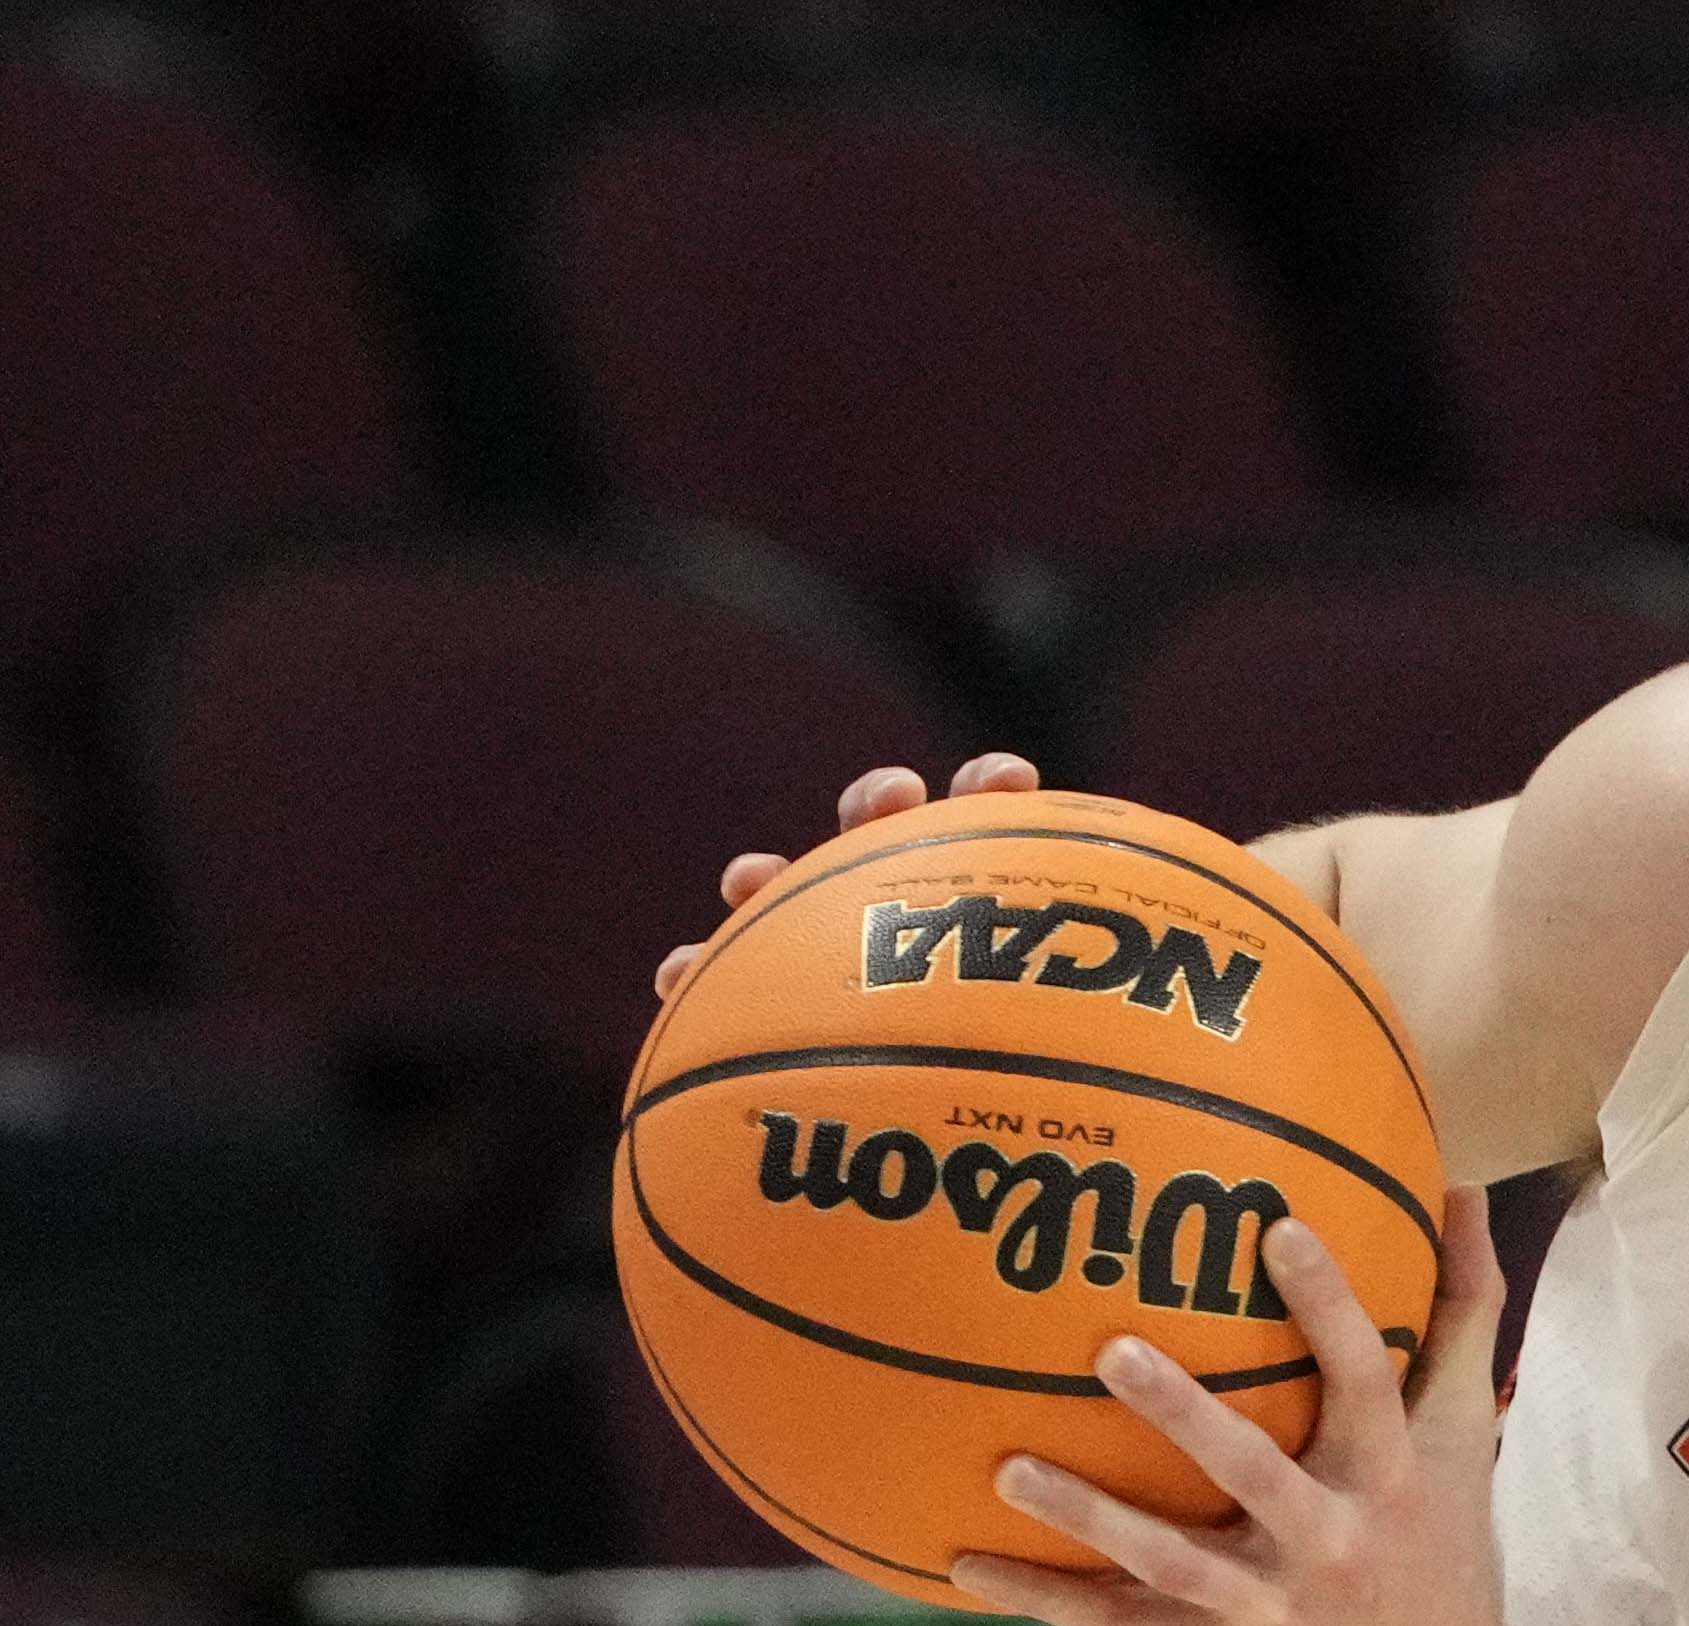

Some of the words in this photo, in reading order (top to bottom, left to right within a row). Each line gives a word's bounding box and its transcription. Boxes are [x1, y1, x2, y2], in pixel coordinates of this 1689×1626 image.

[1112, 886, 1267, 951] OFFICIAL
[863, 895, 1262, 1041] NCAA
[945, 1107, 1023, 1134] NXT
[1038, 1118, 1115, 1147] EVO
[758, 1109, 1290, 1321] Wilson
